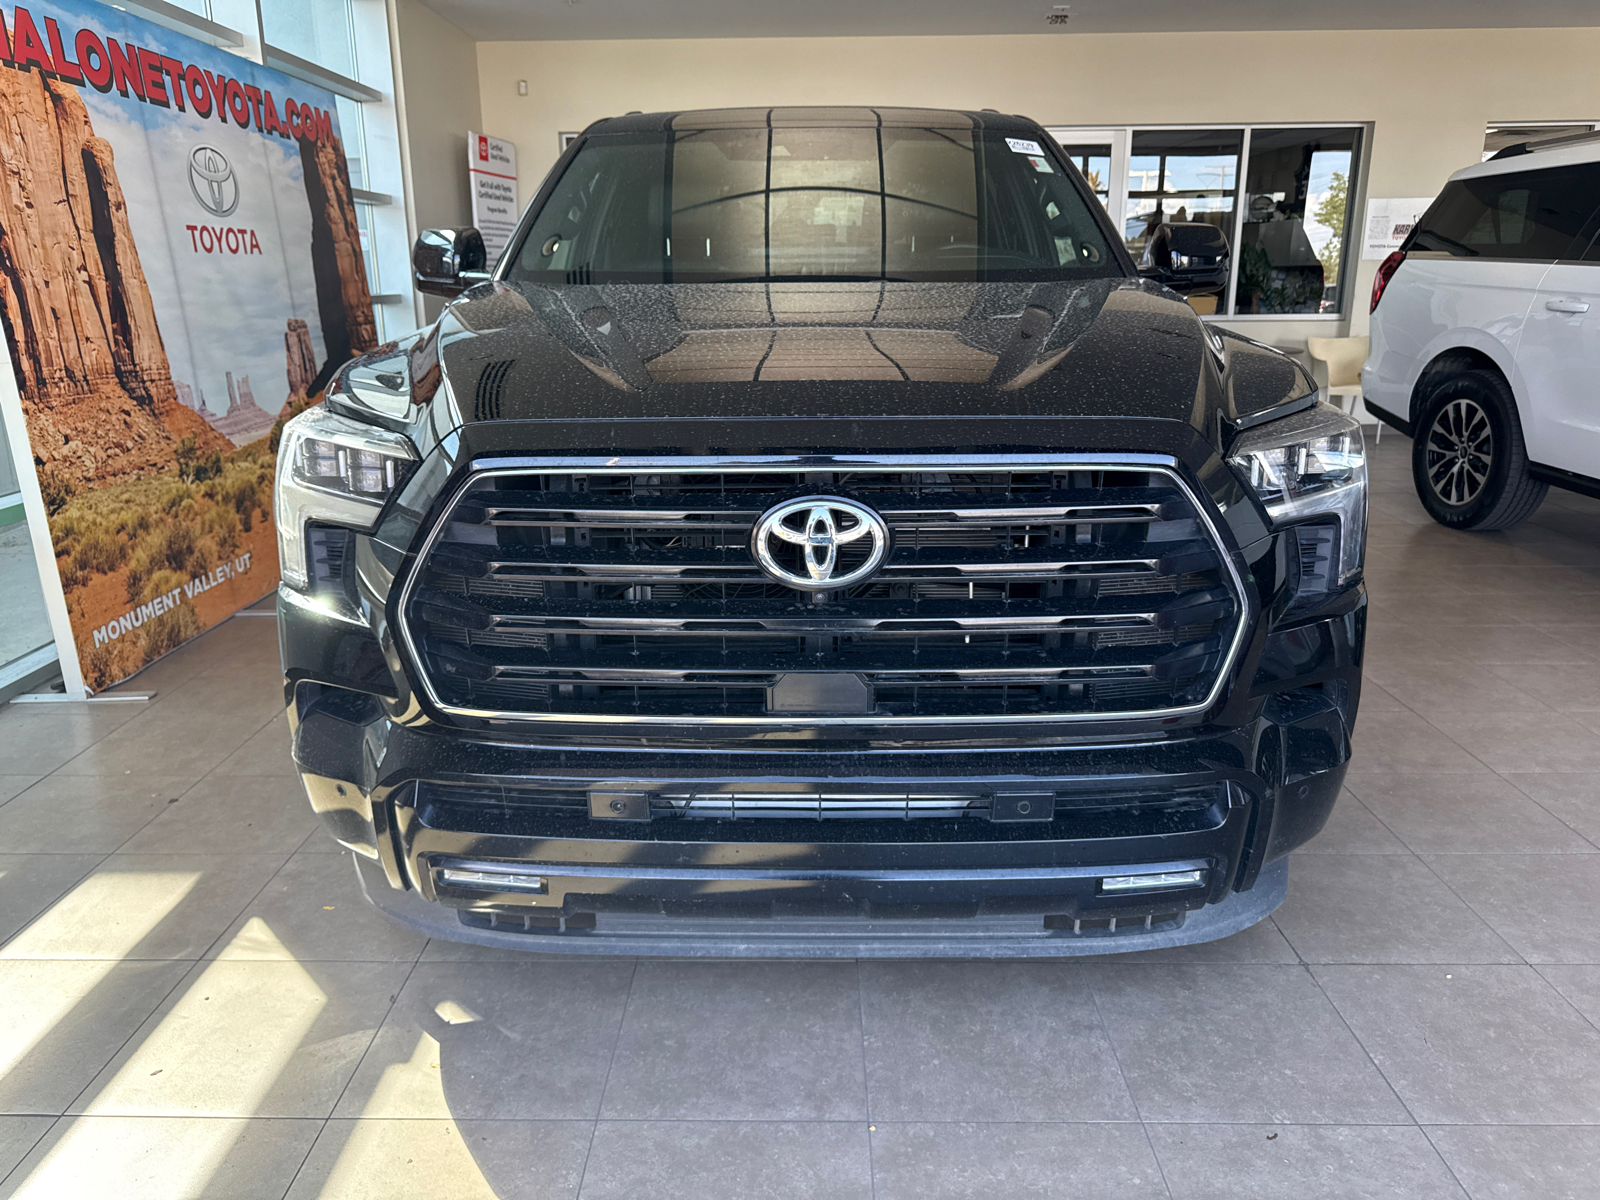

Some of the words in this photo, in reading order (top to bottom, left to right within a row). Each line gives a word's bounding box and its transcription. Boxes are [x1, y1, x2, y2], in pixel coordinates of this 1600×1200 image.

[0, 5, 335, 146] ALONETOYOTA.COM
[186, 224, 262, 255] TOYOTA
[93, 587, 183, 649] MONUMENT
[183, 561, 236, 599] VALLEY,
[234, 553, 251, 573] UT
